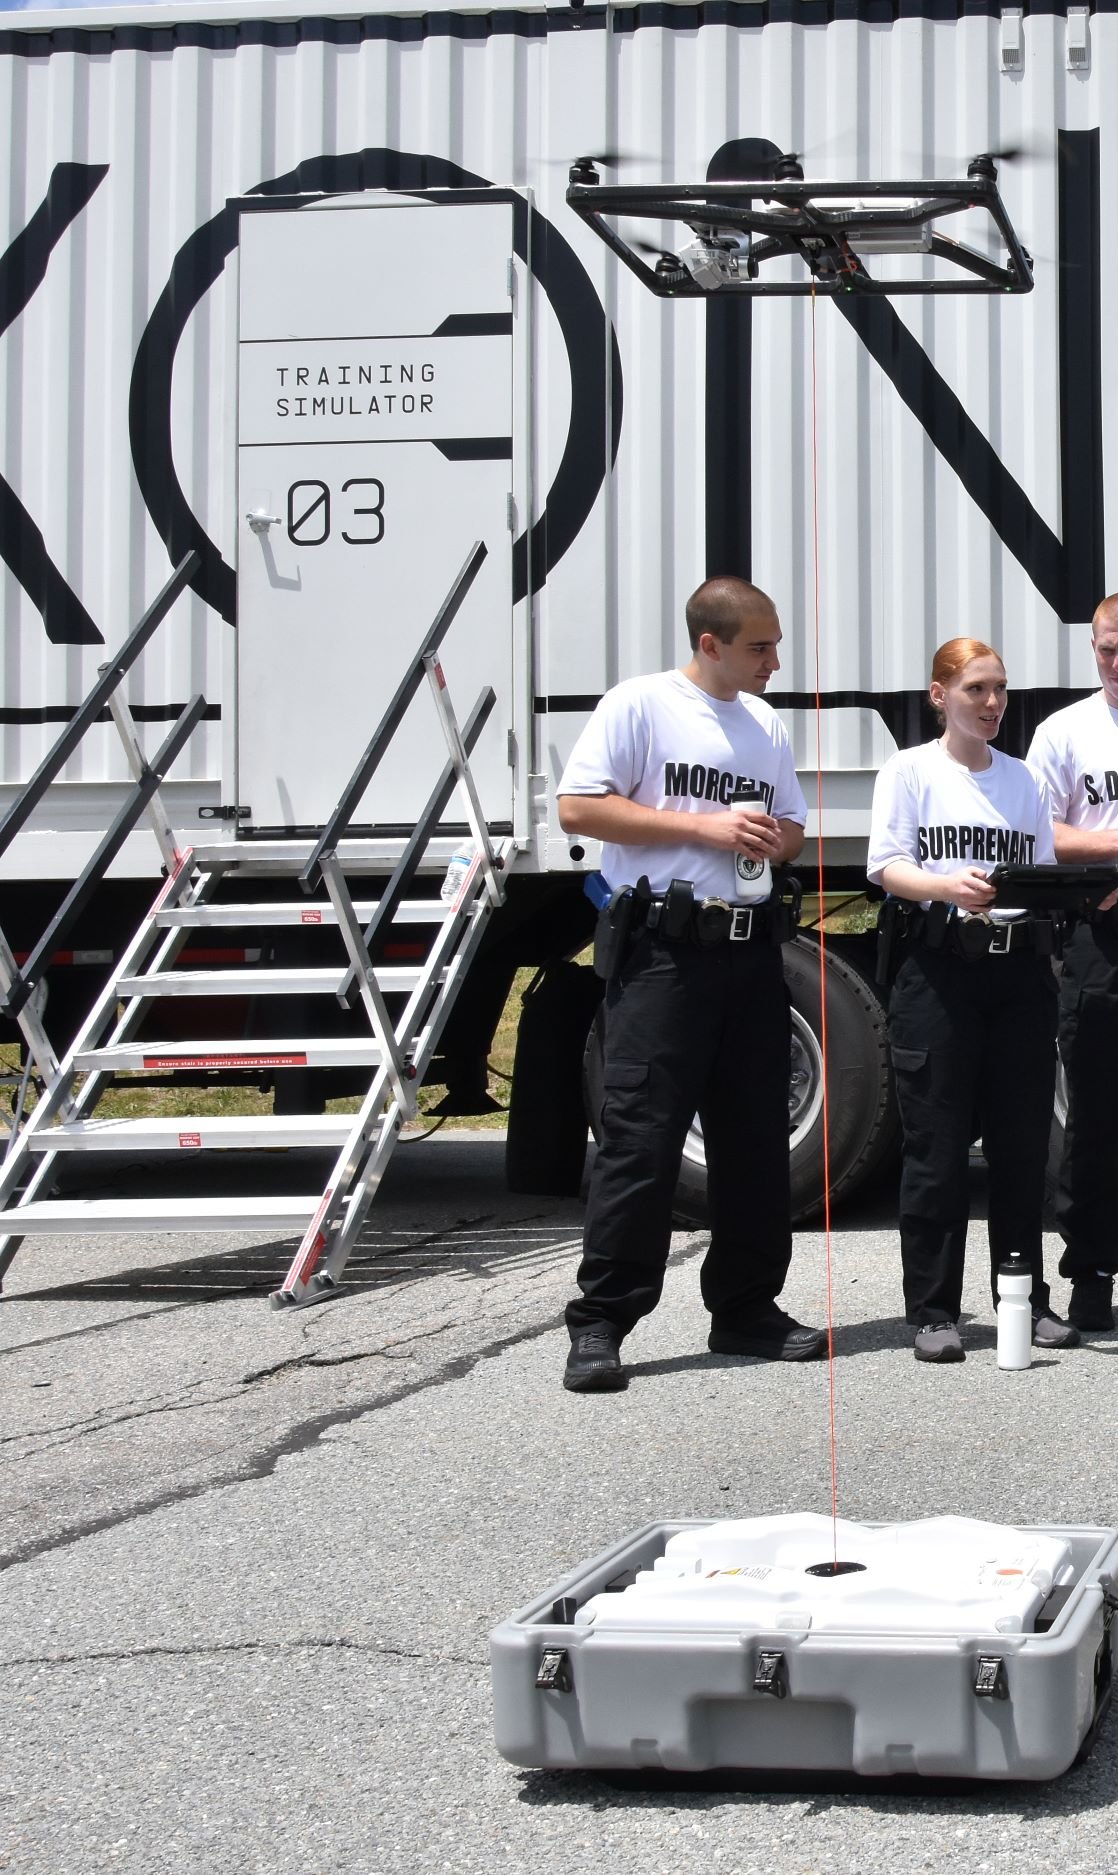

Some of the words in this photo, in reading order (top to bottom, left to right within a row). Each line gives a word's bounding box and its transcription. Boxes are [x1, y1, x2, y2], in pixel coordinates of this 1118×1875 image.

[276, 363, 435, 387] TRAINING
[276, 394, 434, 417] SIMULATOR
[287, 477, 385, 547] 03
[1084, 774, 1104, 806] S.
[919, 825, 1036, 865] SURPRENANT
